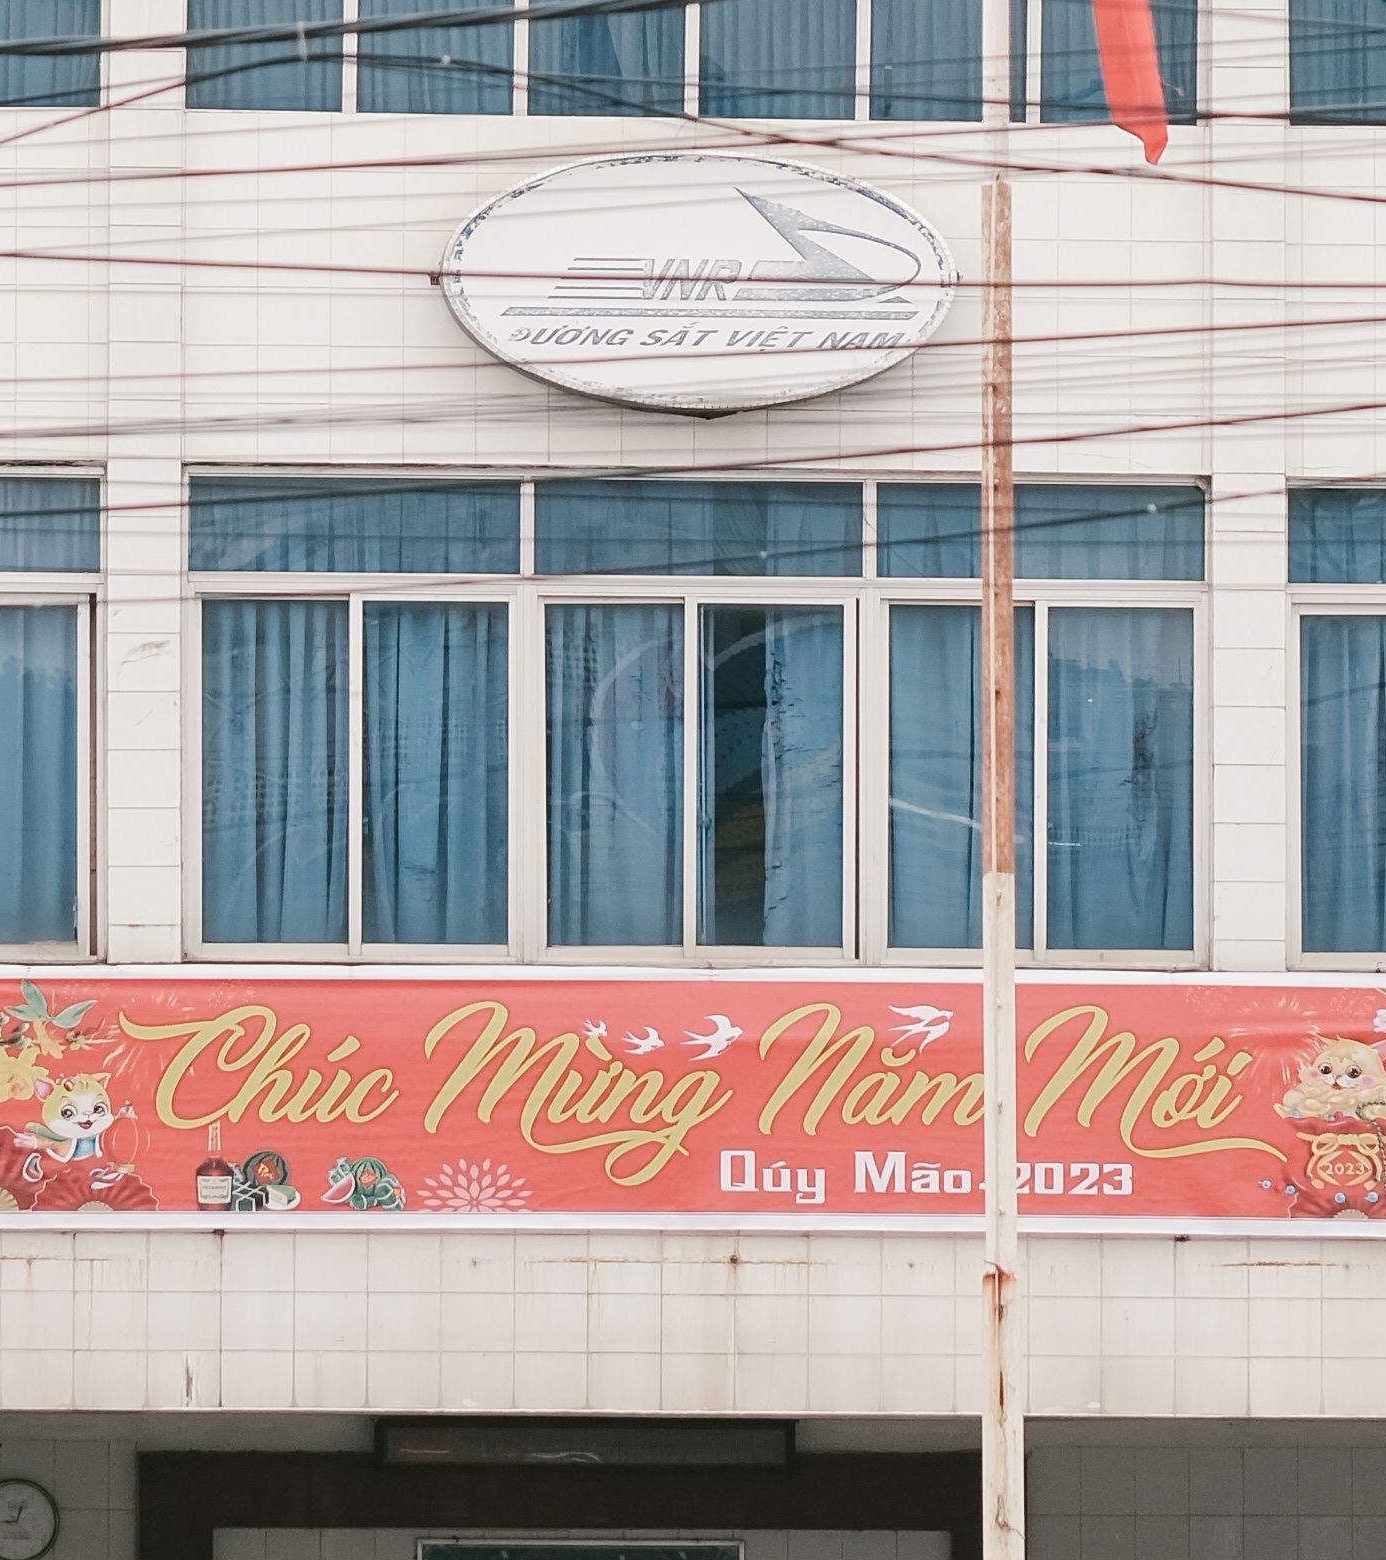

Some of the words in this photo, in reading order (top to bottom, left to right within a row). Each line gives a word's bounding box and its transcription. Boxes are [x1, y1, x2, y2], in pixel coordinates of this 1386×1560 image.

[643, 259, 741, 301] VNR
[640, 321, 718, 347] SẮT
[726, 325, 816, 352] VIỆT
[816, 332, 907, 350] NAM
[118, 1005, 399, 1130] Chúc
[424, 1001, 733, 1186] Mừng
[759, 1002, 985, 1135] Năm
[1024, 1005, 1288, 1163] Mới
[1325, 1163, 1365, 1175] 2023
